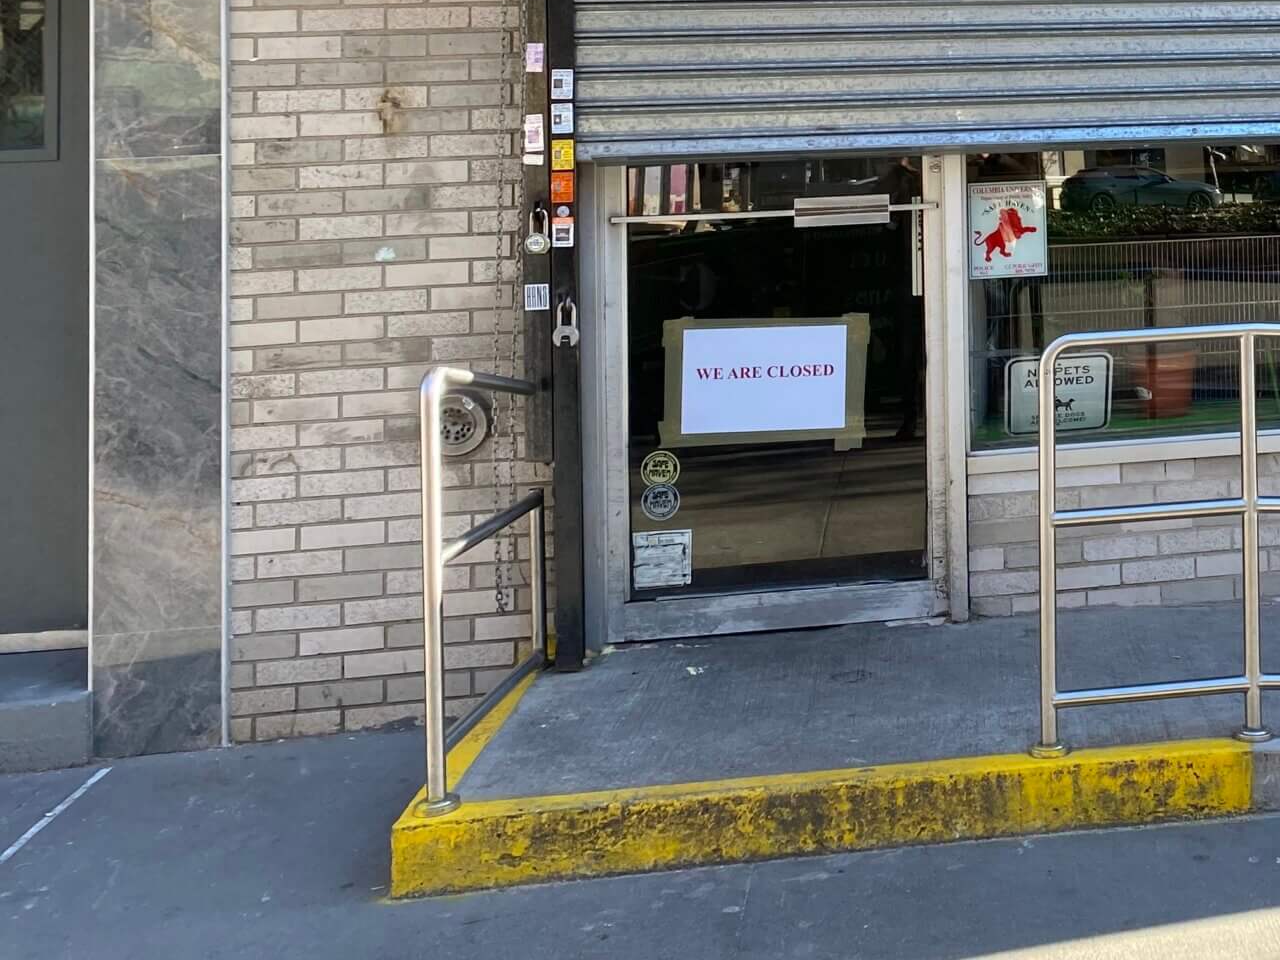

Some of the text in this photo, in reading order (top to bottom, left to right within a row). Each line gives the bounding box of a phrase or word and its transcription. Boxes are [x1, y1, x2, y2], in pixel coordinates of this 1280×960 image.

[696, 363, 834, 380] WE ARE CLOSED
[1024, 375, 1094, 388] ALOWED
